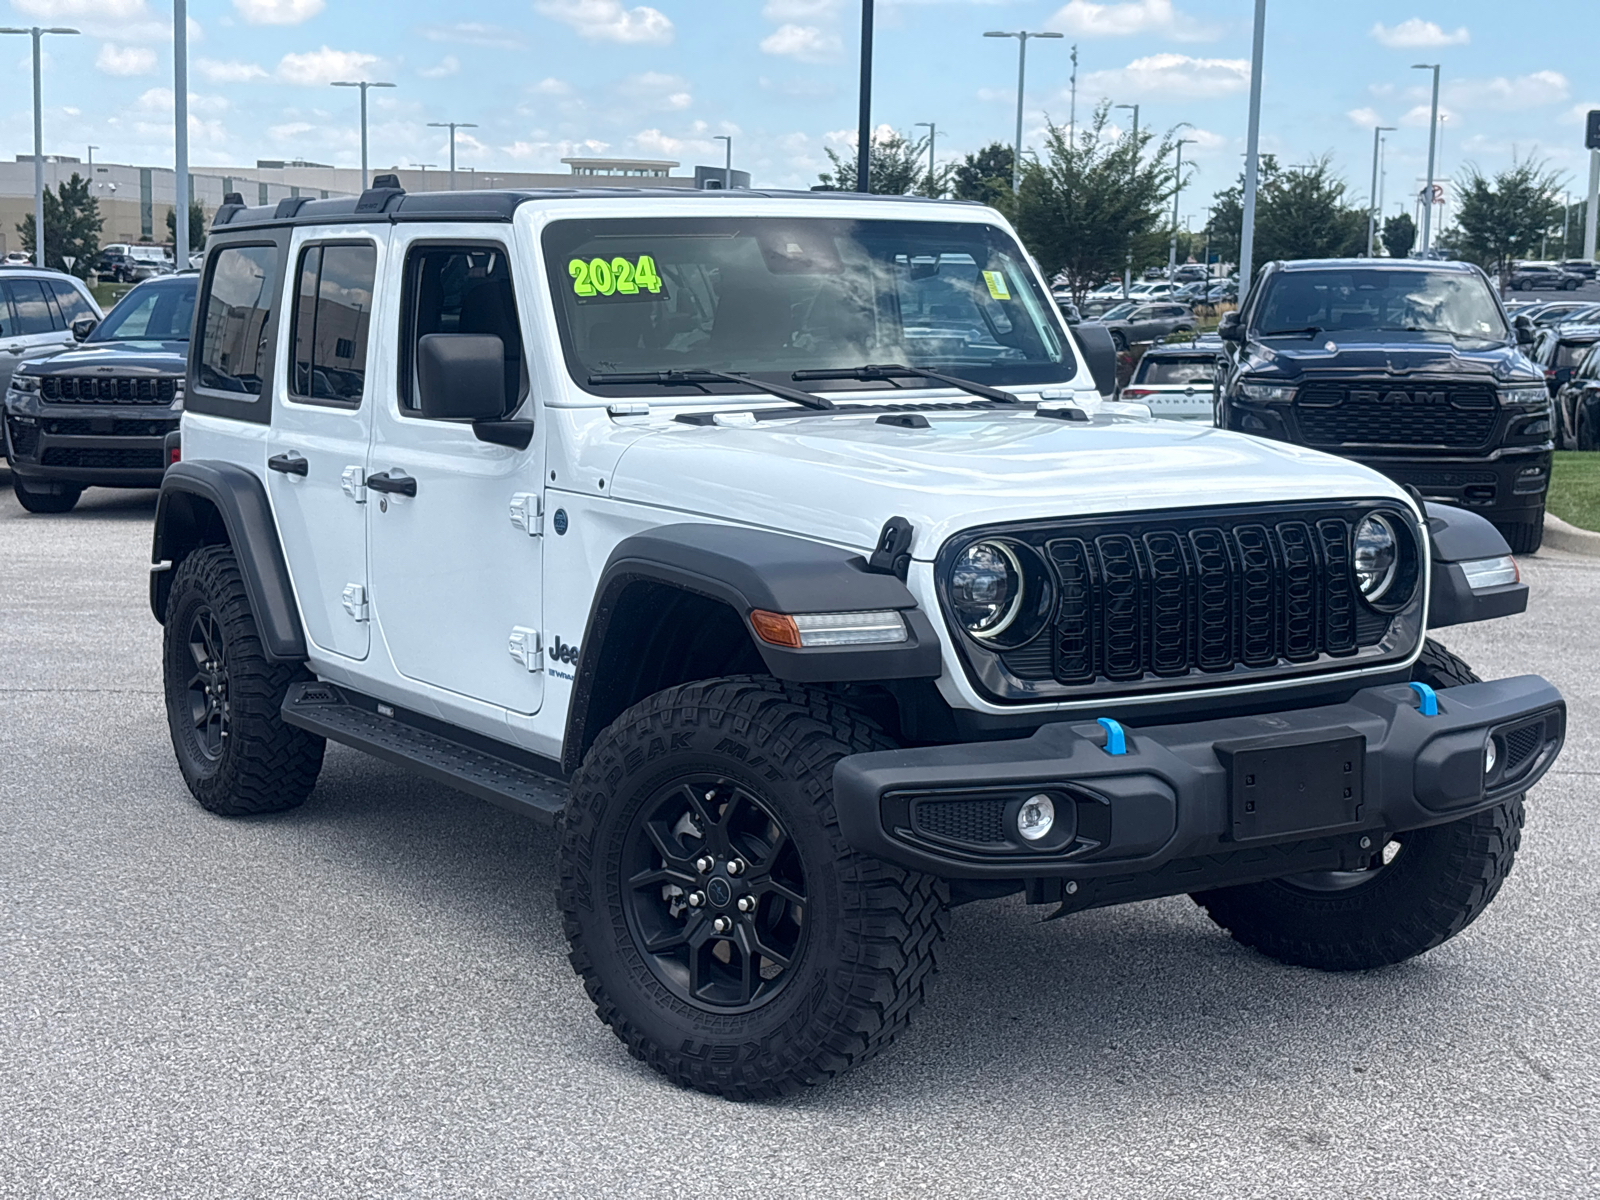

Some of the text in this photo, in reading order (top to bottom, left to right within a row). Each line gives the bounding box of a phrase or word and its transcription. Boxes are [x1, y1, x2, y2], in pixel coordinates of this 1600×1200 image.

[568, 255, 662, 297] 2024
[1349, 390, 1446, 404] RAM
[549, 635, 579, 667] Jee
